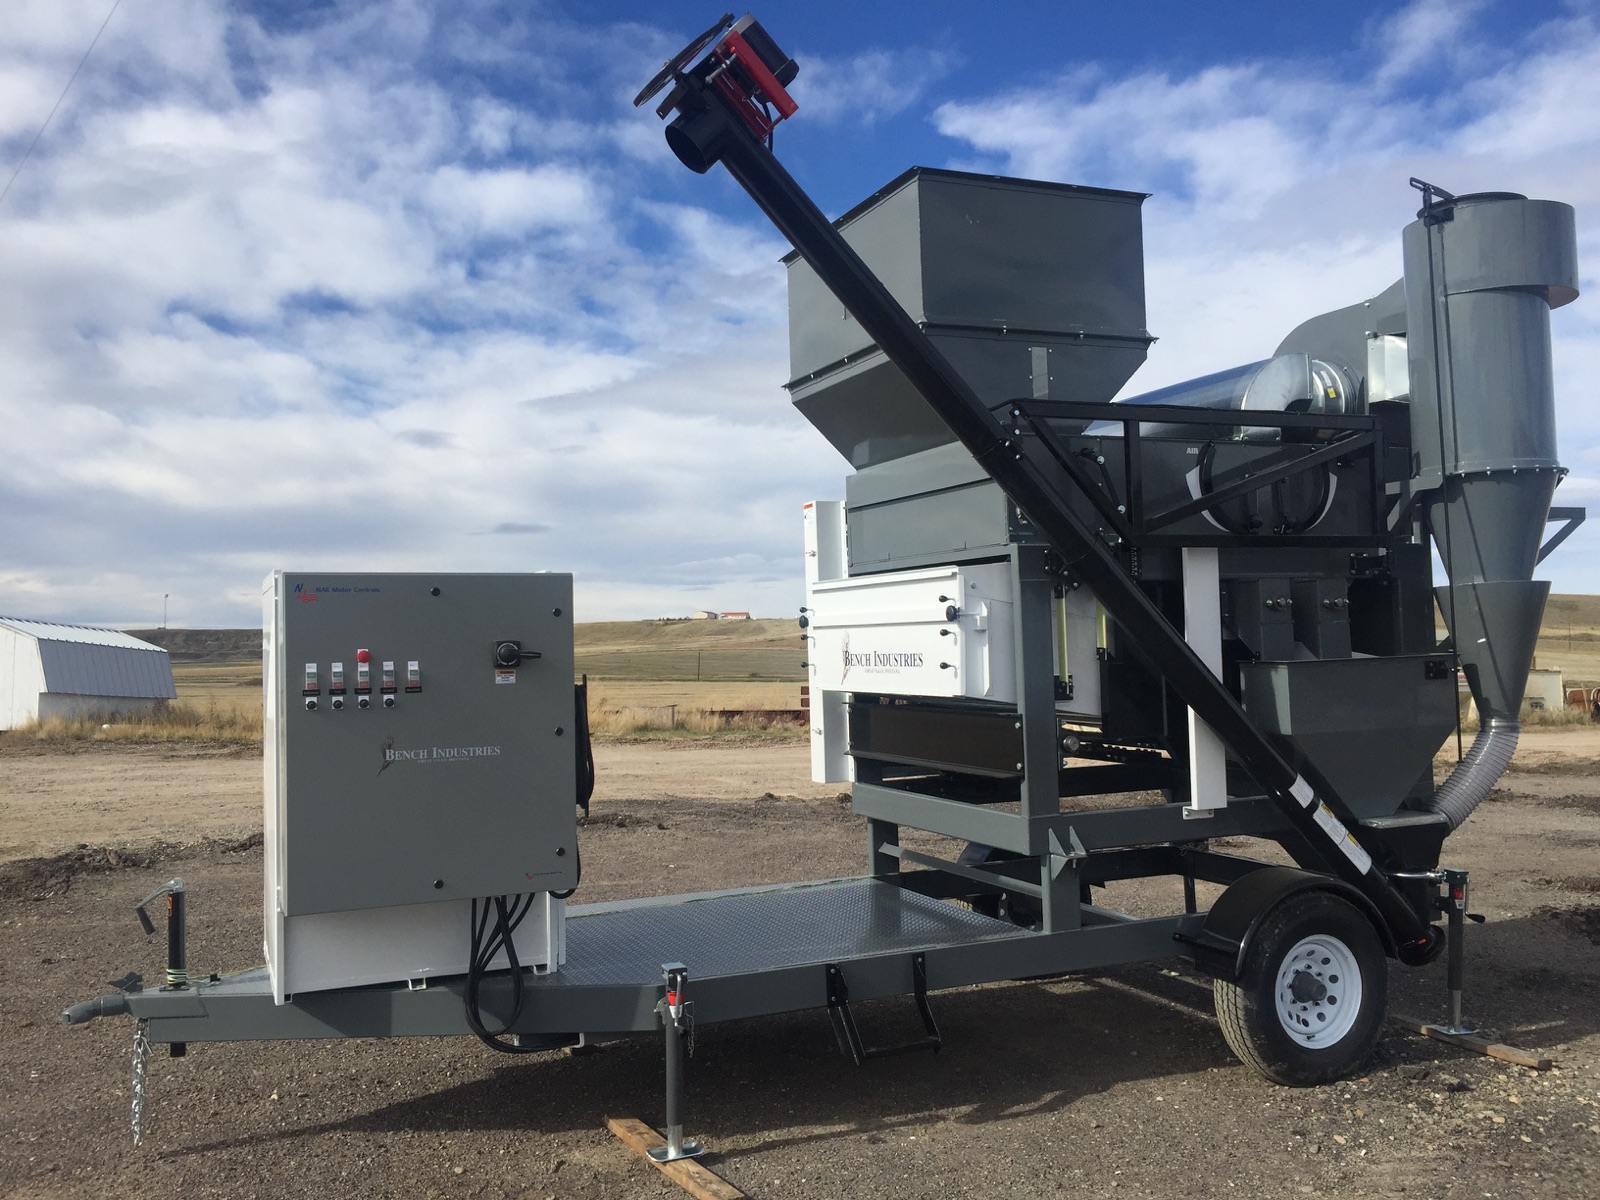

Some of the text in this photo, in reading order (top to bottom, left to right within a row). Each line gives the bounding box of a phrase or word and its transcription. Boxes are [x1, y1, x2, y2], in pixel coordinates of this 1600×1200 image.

[1186, 447, 1199, 455] AIR
[845, 650, 924, 667] BENCH INDUSTRIES
[385, 749, 428, 761] BENCH
[432, 746, 501, 758] INDUSTRIES
